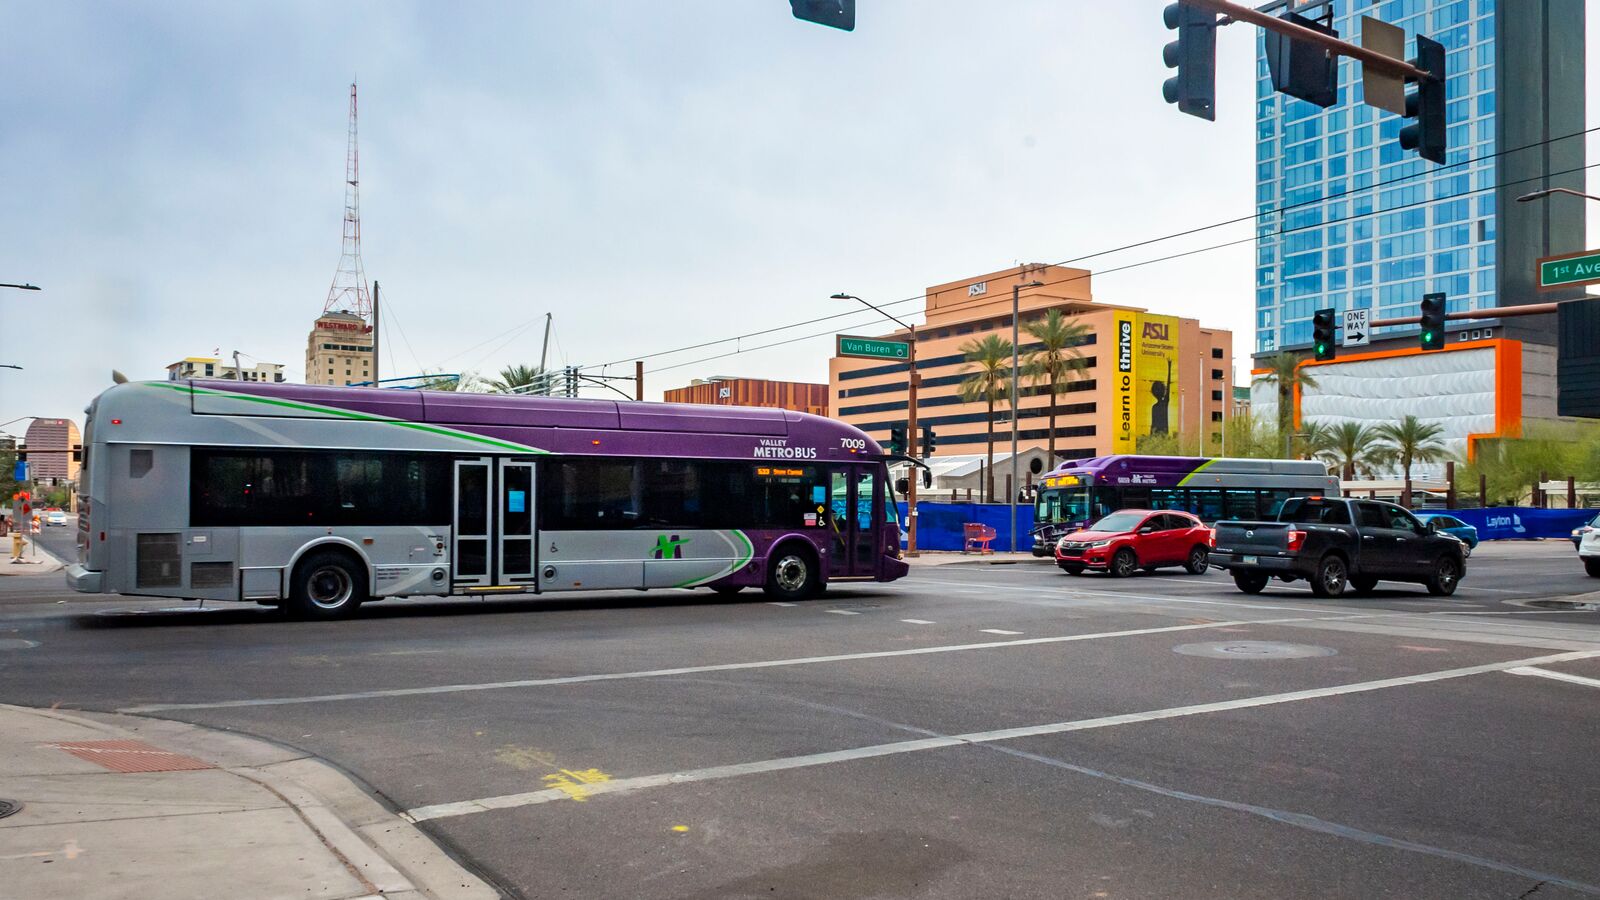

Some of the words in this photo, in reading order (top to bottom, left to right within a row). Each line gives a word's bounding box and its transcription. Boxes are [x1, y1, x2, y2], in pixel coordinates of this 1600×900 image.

[1553, 265, 1570, 278] 1st
[1574, 262, 1600, 275] Ave
[968, 282, 987, 297] ASU
[1347, 311, 1365, 321] ONE
[316, 321, 358, 330] WESTWARD
[1142, 322, 1168, 340] ASU
[1347, 321, 1365, 330] WAY
[847, 342, 863, 352] Van
[865, 343, 890, 354] Buren
[1120, 322, 1130, 371] thrive
[1142, 349, 1165, 358] University
[1121, 375, 1130, 392] to
[1120, 395, 1130, 441] Learn
[760, 439, 787, 447] VALLEY
[840, 438, 866, 449] 7009
[1486, 515, 1511, 528] Layton
